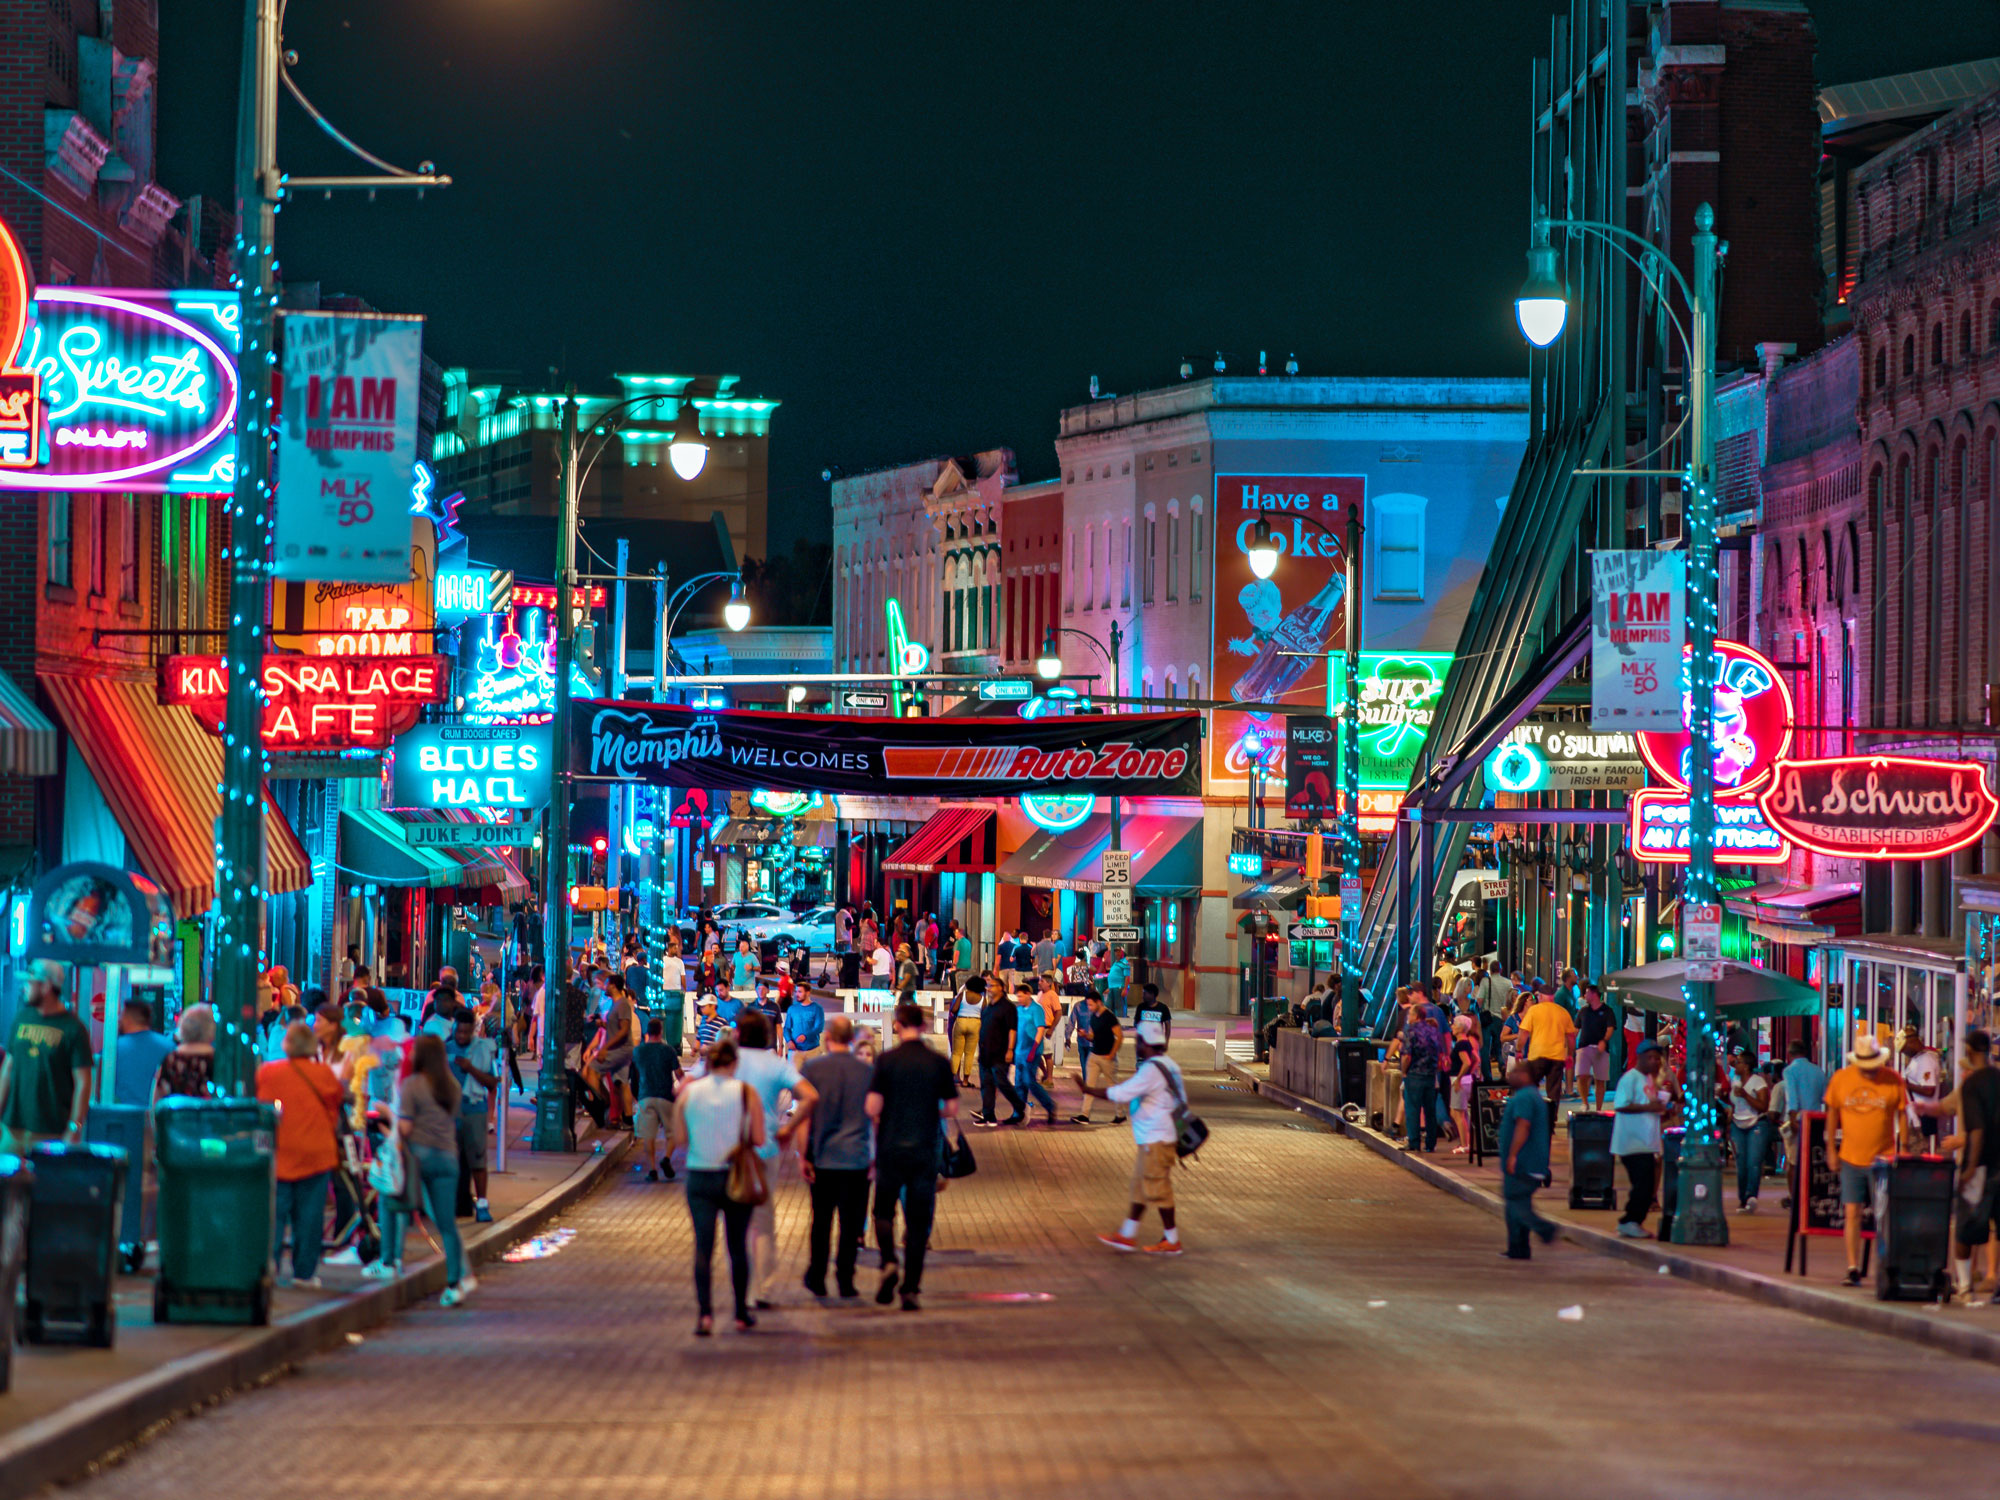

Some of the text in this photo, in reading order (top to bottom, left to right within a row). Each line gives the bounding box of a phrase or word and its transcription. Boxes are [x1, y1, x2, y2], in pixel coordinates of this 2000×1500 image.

[49, 326, 206, 420] Sweets
[307, 374, 397, 420] I AM
[306, 428, 395, 452] MEMPHIS
[320, 478, 371, 498] MLK
[1241, 484, 1339, 511] Have a
[338, 499, 374, 527] 50
[1236, 518, 1341, 557] Coke
[1609, 592, 1671, 622] I AM
[346, 607, 410, 631] TAP
[318, 633, 413, 656] ROOM
[1610, 628, 1671, 644] MEMPHIS
[1621, 662, 1656, 676] MLK
[182, 667, 284, 696] KINS
[995, 687, 1026, 695] ONE WAY
[1633, 676, 1658, 695] 50
[856, 697, 883, 706] ONE WAY
[263, 704, 377, 739] AFE
[444, 729, 517, 739] RUM BOOGIE CAFE'S
[1259, 730, 1287, 739] DRIN
[419, 744, 538, 772] BLUES
[590, 729, 1188, 781] Memphis WELCOMES AutoZone
[1358, 757, 1416, 768] UTHERN
[1549, 765, 1588, 775] WORLD
[432, 777, 525, 803] HALL
[1570, 776, 1628, 785] IRISH BAR
[1772, 768, 1985, 816] A. Schwab
[1643, 805, 1690, 823] POR
[415, 827, 525, 843] JUKE JOINT
[1812, 825, 1950, 843] ESTABLISHED 1876
[1105, 869, 1128, 882] 25
[1343, 879, 1358, 888] NO
[1489, 888, 1507, 897] BAR
